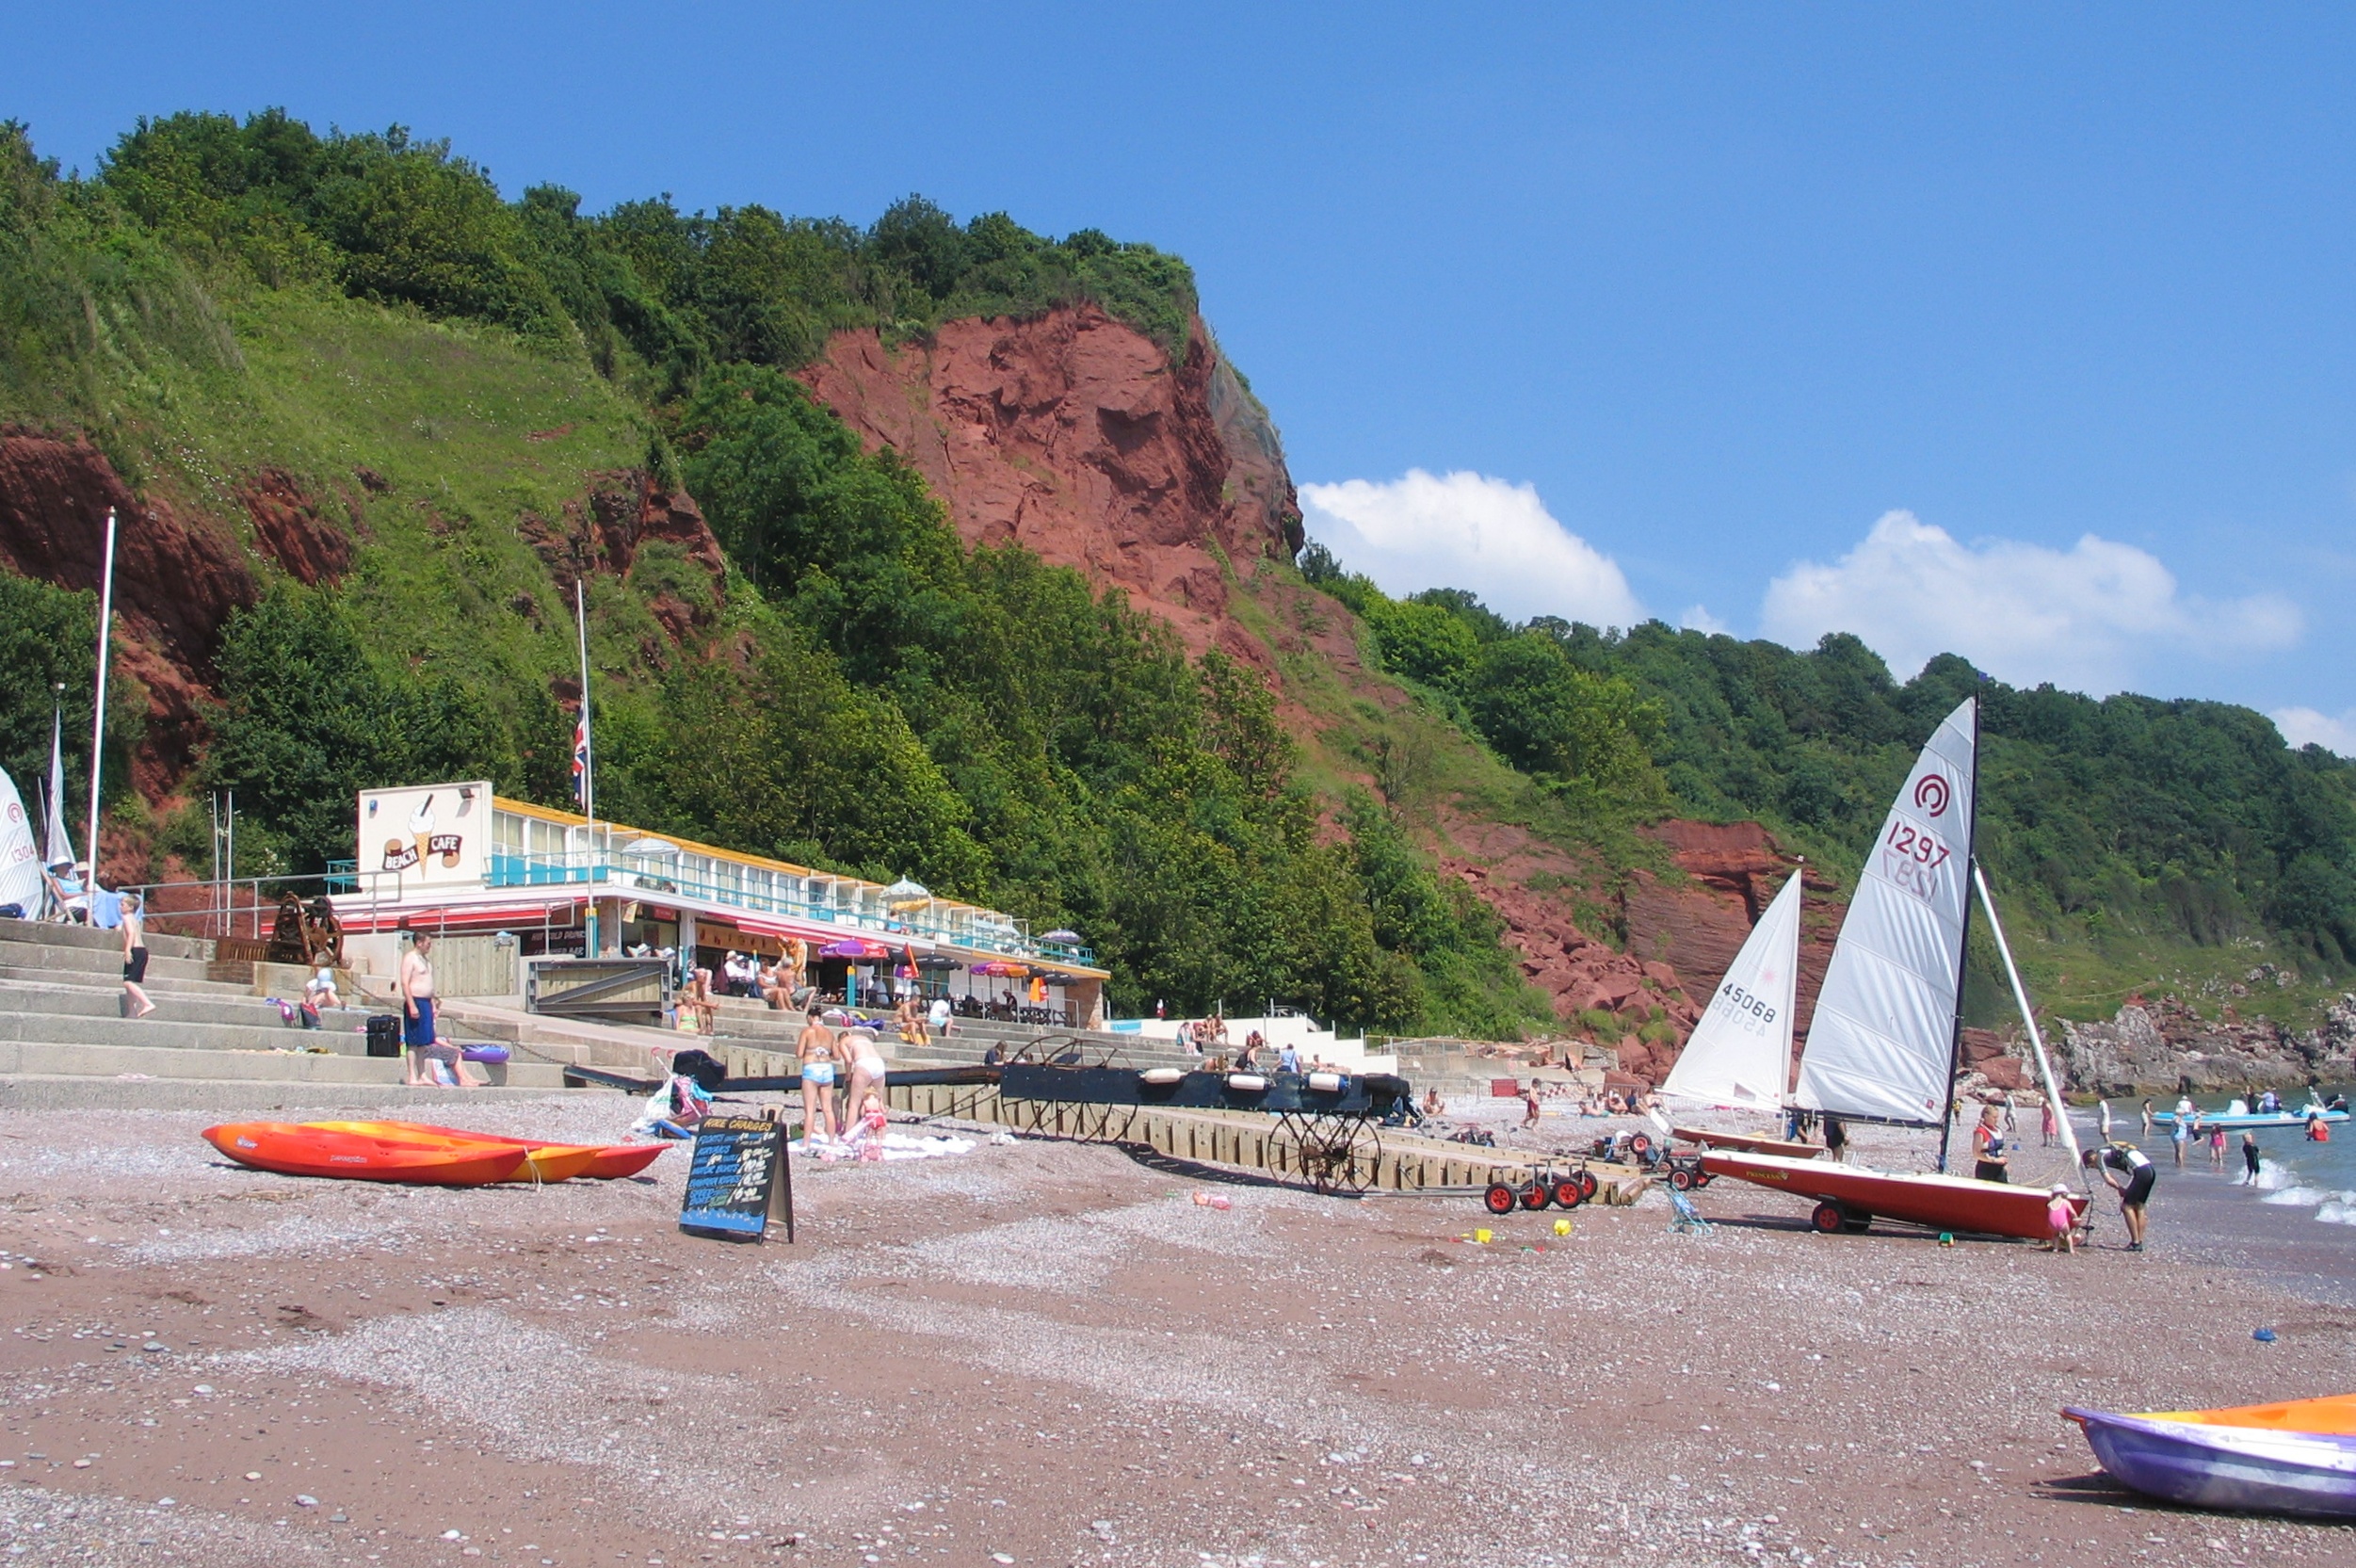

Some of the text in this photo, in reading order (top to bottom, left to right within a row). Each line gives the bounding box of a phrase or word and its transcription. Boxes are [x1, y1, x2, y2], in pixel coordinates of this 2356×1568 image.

[385, 836, 459, 869] BEACH CAFE
[1886, 820, 1950, 869] 1297
[1722, 982, 1776, 1023] 45068
[729, 1120, 772, 1131] CHARGES
